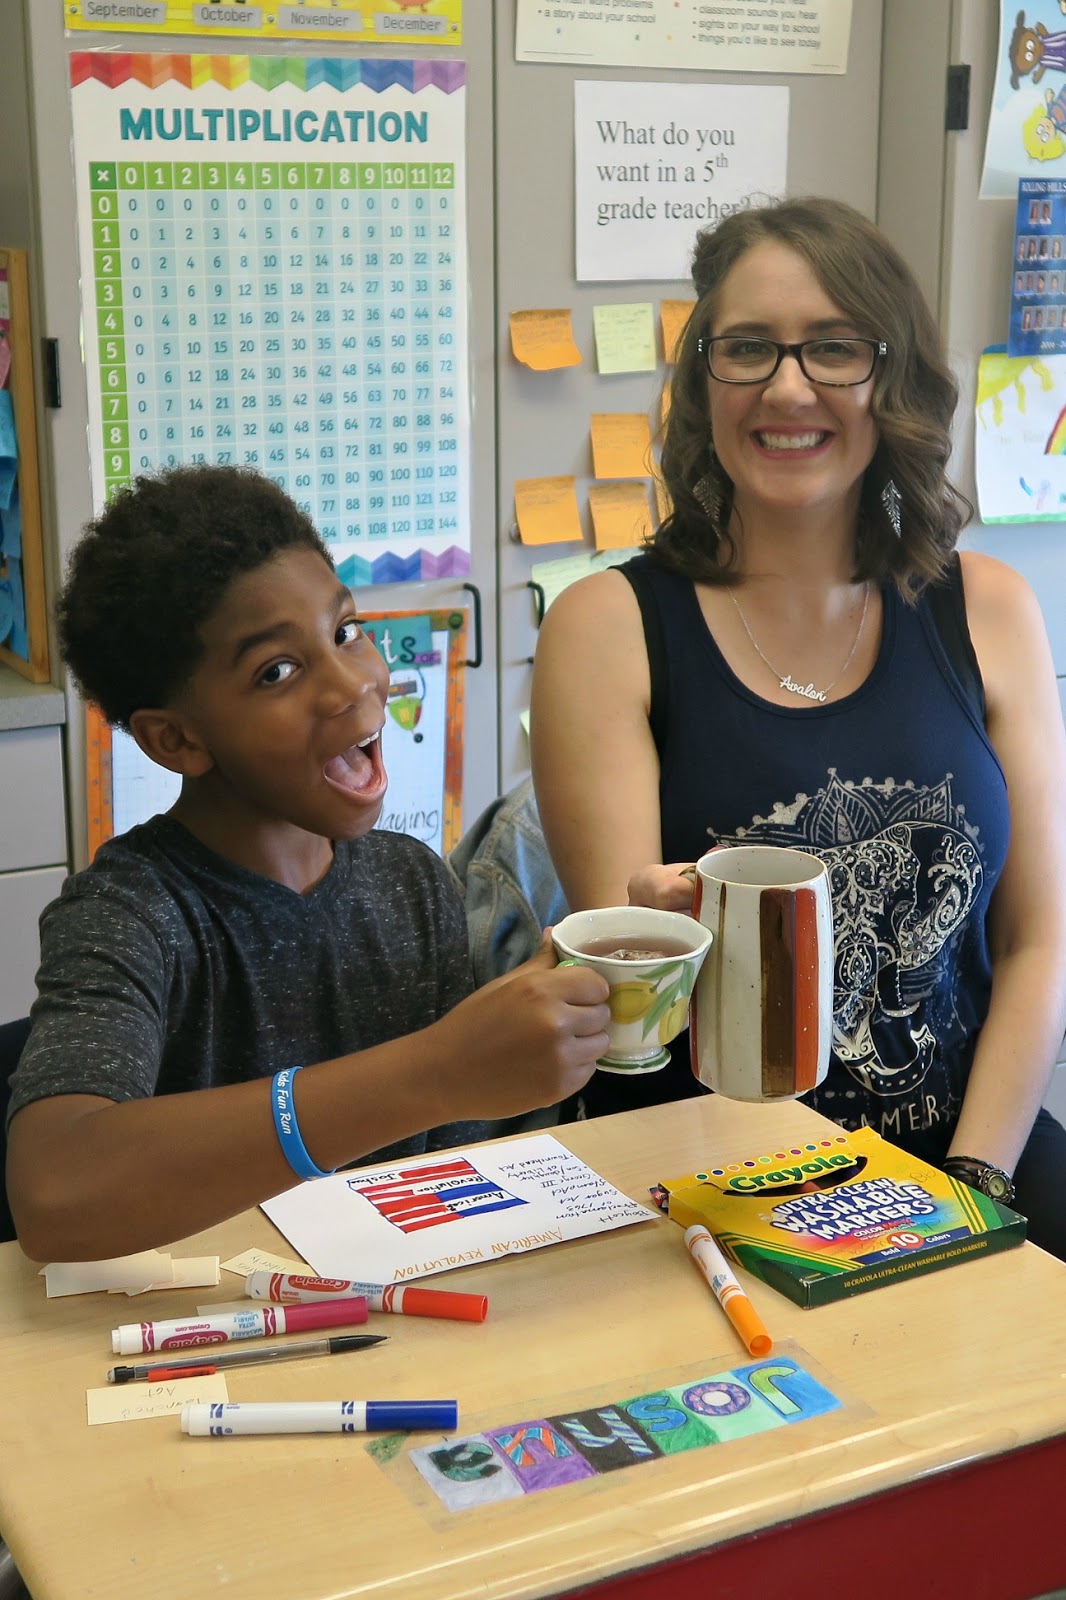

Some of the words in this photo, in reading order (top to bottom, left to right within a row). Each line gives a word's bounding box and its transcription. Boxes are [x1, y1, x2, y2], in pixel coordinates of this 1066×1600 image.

[87, 2, 159, 18] September
[201, 7, 253, 22] October
[544, 9, 551, 17] a
[553, 9, 575, 20] story
[578, 10, 603, 20] about
[605, 13, 625, 23] your
[626, 13, 657, 24] school
[699, 5, 745, 16] classroom
[747, 8, 779, 18] sounds
[781, 10, 796, 20] you
[799, 10, 818, 20] hear
[291, 12, 350, 27] November
[383, 16, 441, 31] December
[699, 19, 726, 31] sights
[727, 21, 739, 30] on
[741, 23, 761, 33] your
[762, 24, 779, 33] way
[782, 23, 790, 32] to
[793, 25, 820, 34] school
[698, 34, 725, 46] things
[753, 36, 768, 45] like
[770, 37, 779, 46] to
[781, 38, 796, 47] see
[798, 39, 821, 49] today
[119, 107, 429, 144] MULTIPLICATION
[596, 120, 656, 145] What
[662, 121, 690, 145] do
[696, 127, 736, 152] you
[125, 167, 138, 185] 0
[154, 167, 165, 185] 1
[181, 167, 192, 185] 2
[209, 167, 219, 185] 3
[235, 167, 246, 185] 4
[262, 167, 272, 185] 5
[287, 167, 298, 185] 6
[314, 167, 324, 184] 7
[339, 167, 351, 185] 8
[365, 167, 375, 184] 9
[385, 168, 404, 184] 10
[411, 168, 427, 184] 11
[434, 168, 451, 184] 12
[596, 162, 650, 182] want
[657, 159, 678, 182] in
[684, 165, 696, 182] a
[597, 196, 657, 226] grade
[102, 255, 113, 273] 2
[131, 256, 140, 270] 0
[159, 256, 167, 270] 2
[186, 256, 195, 269] 4
[213, 255, 221, 269] 6
[240, 255, 248, 268] 8
[263, 254, 277, 268] 10
[289, 254, 303, 267] 12
[315, 254, 329, 267] 14
[340, 253, 354, 266] 16
[365, 253, 378, 266] 18
[389, 252, 404, 265] 20
[414, 252, 427, 265] 22
[438, 252, 452, 264] 24
[106, 341, 117, 359] 5
[135, 343, 145, 356] 0
[163, 342, 171, 355] 5
[187, 341, 201, 354] 10
[214, 341, 228, 353] 15
[240, 340, 255, 353] 20
[266, 339, 280, 352] 25
[292, 338, 306, 351] 30
[317, 337, 332, 350] 35
[341, 336, 356, 349] 40
[366, 335, 381, 348] 45
[391, 334, 406, 347] 50
[415, 334, 429, 346] 55
[438, 333, 453, 345] 60
[110, 427, 122, 444] 8
[139, 428, 148, 441] 0
[166, 427, 175, 440] 8
[190, 425, 204, 438] 16
[216, 424, 232, 437] 24
[243, 423, 257, 436] 32
[268, 422, 284, 434] 40
[293, 420, 310, 433] 48
[319, 419, 334, 432] 56
[344, 418, 359, 430] 64
[369, 416, 383, 429] 72
[392, 415, 407, 428] 80
[416, 414, 431, 427] 88
[440, 413, 454, 425] 96
[346, 524, 361, 537] 96
[368, 522, 387, 535] 108
[392, 520, 411, 533] 120
[416, 518, 434, 531] 132
[439, 518, 457, 529] 144
[780, 675, 827, 702] Avalon
[276, 1089, 289, 1110] Fun
[279, 1111, 292, 1135] Run
[351, 1173, 397, 1185] Joshua
[507, 1167, 544, 1178] Liberty
[728, 1154, 854, 1191] Crayola
[417, 1175, 485, 1193] Revolution
[585, 1190, 618, 1199] Sugar
[774, 1178, 896, 1216] ULTRA-CLEAN
[556, 1202, 638, 1220] Proclamation
[566, 1202, 594, 1211] 1763
[772, 1185, 931, 1232] WASHABLE
[599, 1210, 650, 1223] Boycott
[810, 1200, 935, 1240] MARKERS
[491, 1226, 563, 1255] AMERICAN
[853, 1226, 884, 1238] COLOR
[890, 1233, 919, 1247] 10
[925, 1233, 951, 1243] Colors
[881, 1247, 900, 1257] Bold
[393, 1247, 485, 1281] REVOLUTION
[851, 1273, 878, 1287] CRAYOLA
[878, 1261, 917, 1278] ULTRA-CLEAN
[916, 1252, 946, 1268] WASHABLE
[946, 1248, 962, 1259] BOLD
[961, 1240, 988, 1254] MARKERS
[294, 1276, 346, 1288] Crayola
[175, 1323, 211, 1333] Crayola.com
[231, 1328, 263, 1338] WASHABLE
[168, 1335, 224, 1349] Crayola
